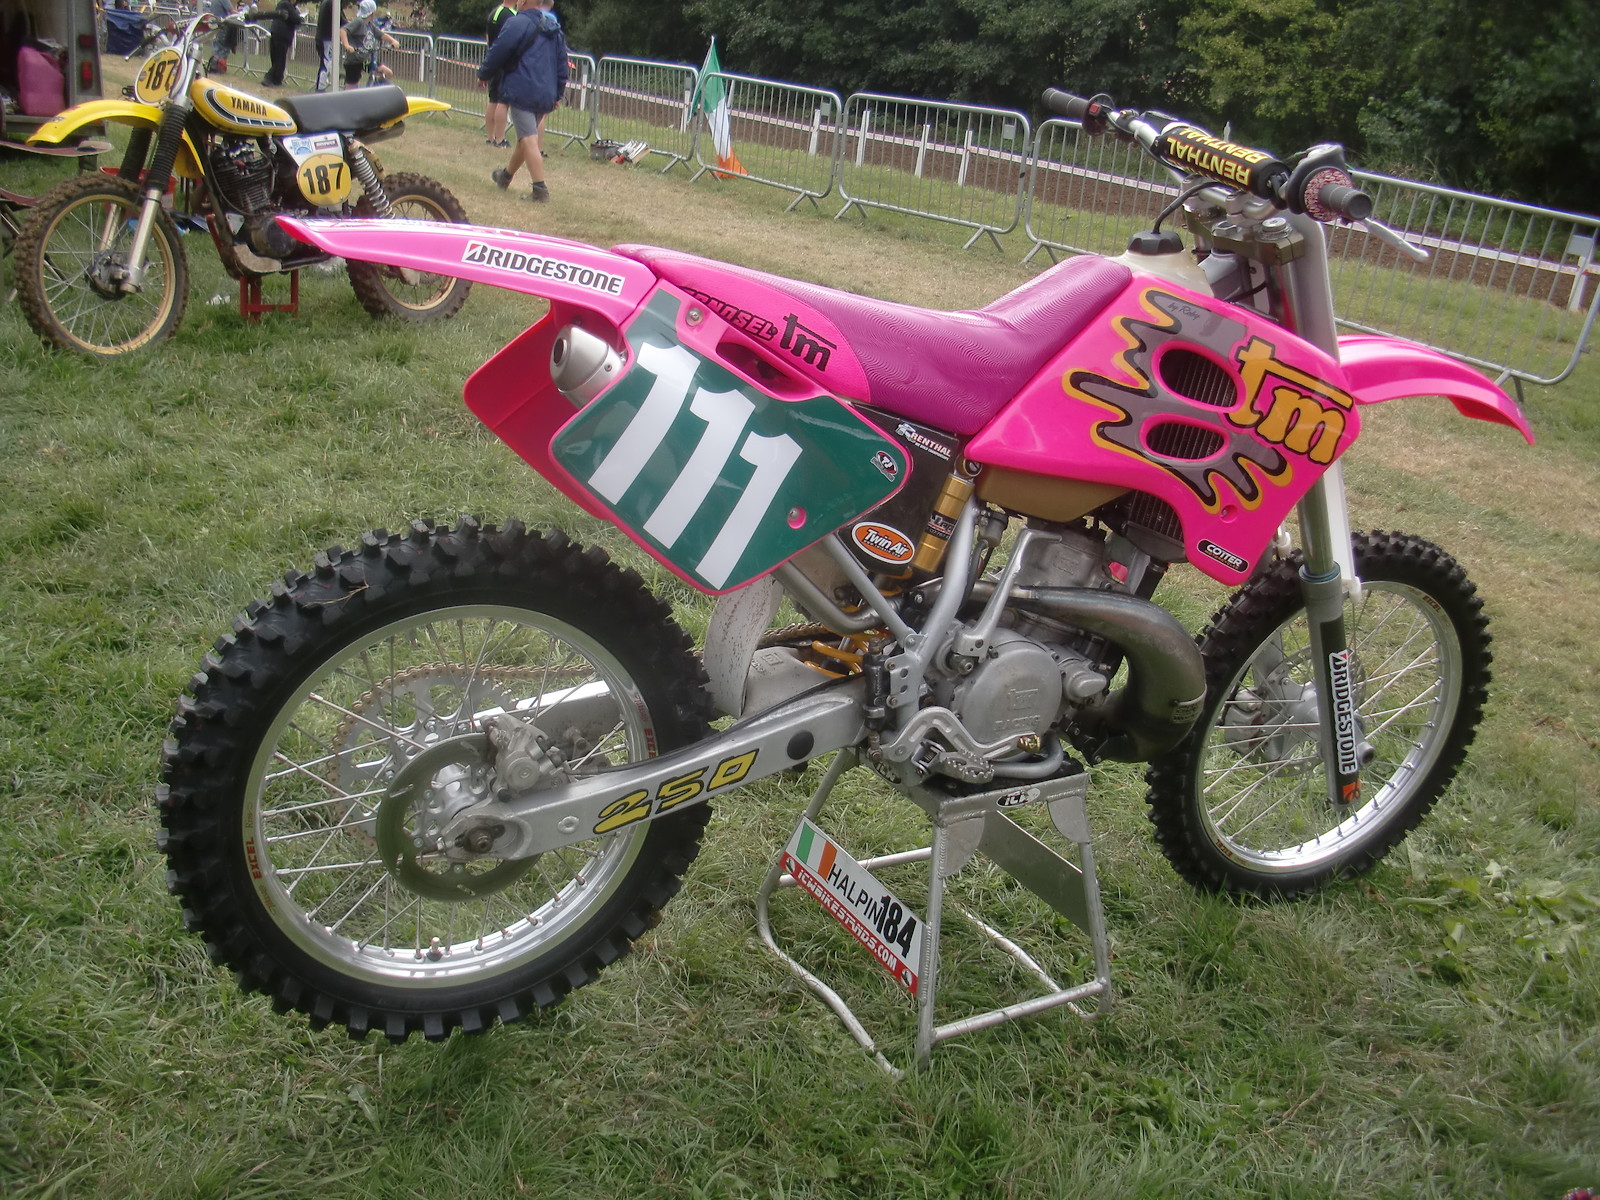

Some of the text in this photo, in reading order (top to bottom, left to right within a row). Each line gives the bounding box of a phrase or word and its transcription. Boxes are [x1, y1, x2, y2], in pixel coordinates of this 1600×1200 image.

[146, 59, 179, 91] 187
[231, 96, 268, 117] YAMAHA
[1167, 136, 1251, 187] RENTHAL
[1179, 128, 1268, 164] RENTHAL
[303, 163, 344, 195] 187
[465, 243, 622, 293] BRIDGESTONE
[780, 313, 837, 371] tm
[1223, 335, 1354, 465] tm
[587, 341, 803, 591] 111
[911, 432, 951, 457] RENTHAL
[864, 528, 892, 549] Twin
[889, 542, 910, 556] Air
[1206, 544, 1243, 567] COTTER
[1332, 653, 1356, 773] BRIDGESTONE
[592, 748, 760, 835] 250
[246, 836, 263, 879] EXCEL
[827, 863, 917, 959] HALPIN 184
